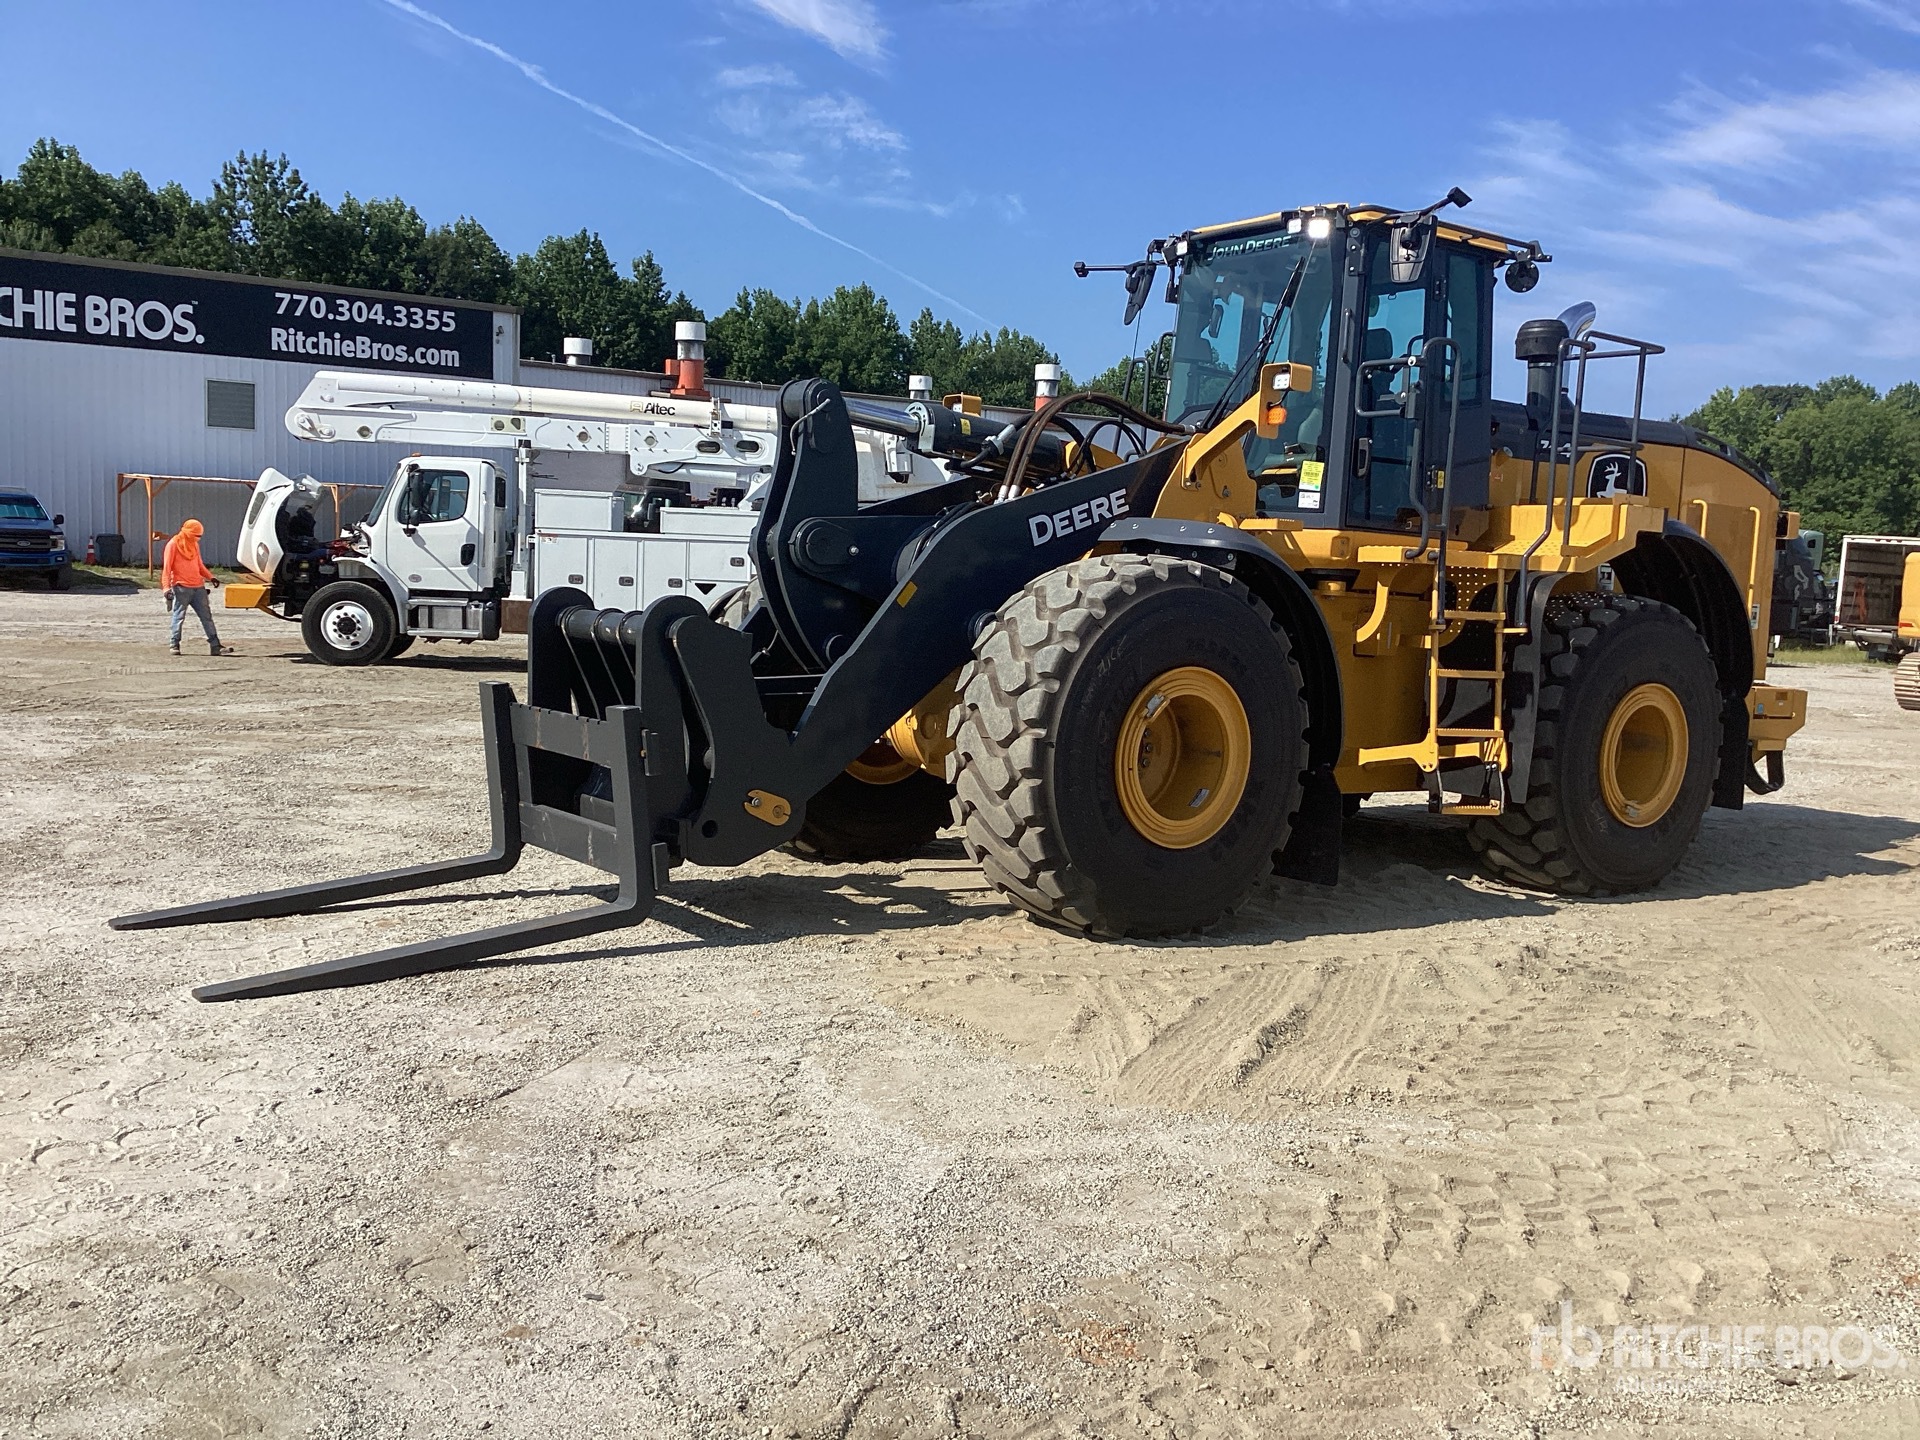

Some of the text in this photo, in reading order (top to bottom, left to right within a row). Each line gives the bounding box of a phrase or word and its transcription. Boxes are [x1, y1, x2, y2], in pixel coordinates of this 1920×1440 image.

[1207, 235, 1292, 261] JOHN DEERE
[84, 294, 205, 345] BROS.
[274, 291, 456, 333] 770.304.3355
[270, 327, 460, 368] RitchieBros.com
[643, 402, 676, 416] Altec
[1028, 488, 1130, 547] DEERE
